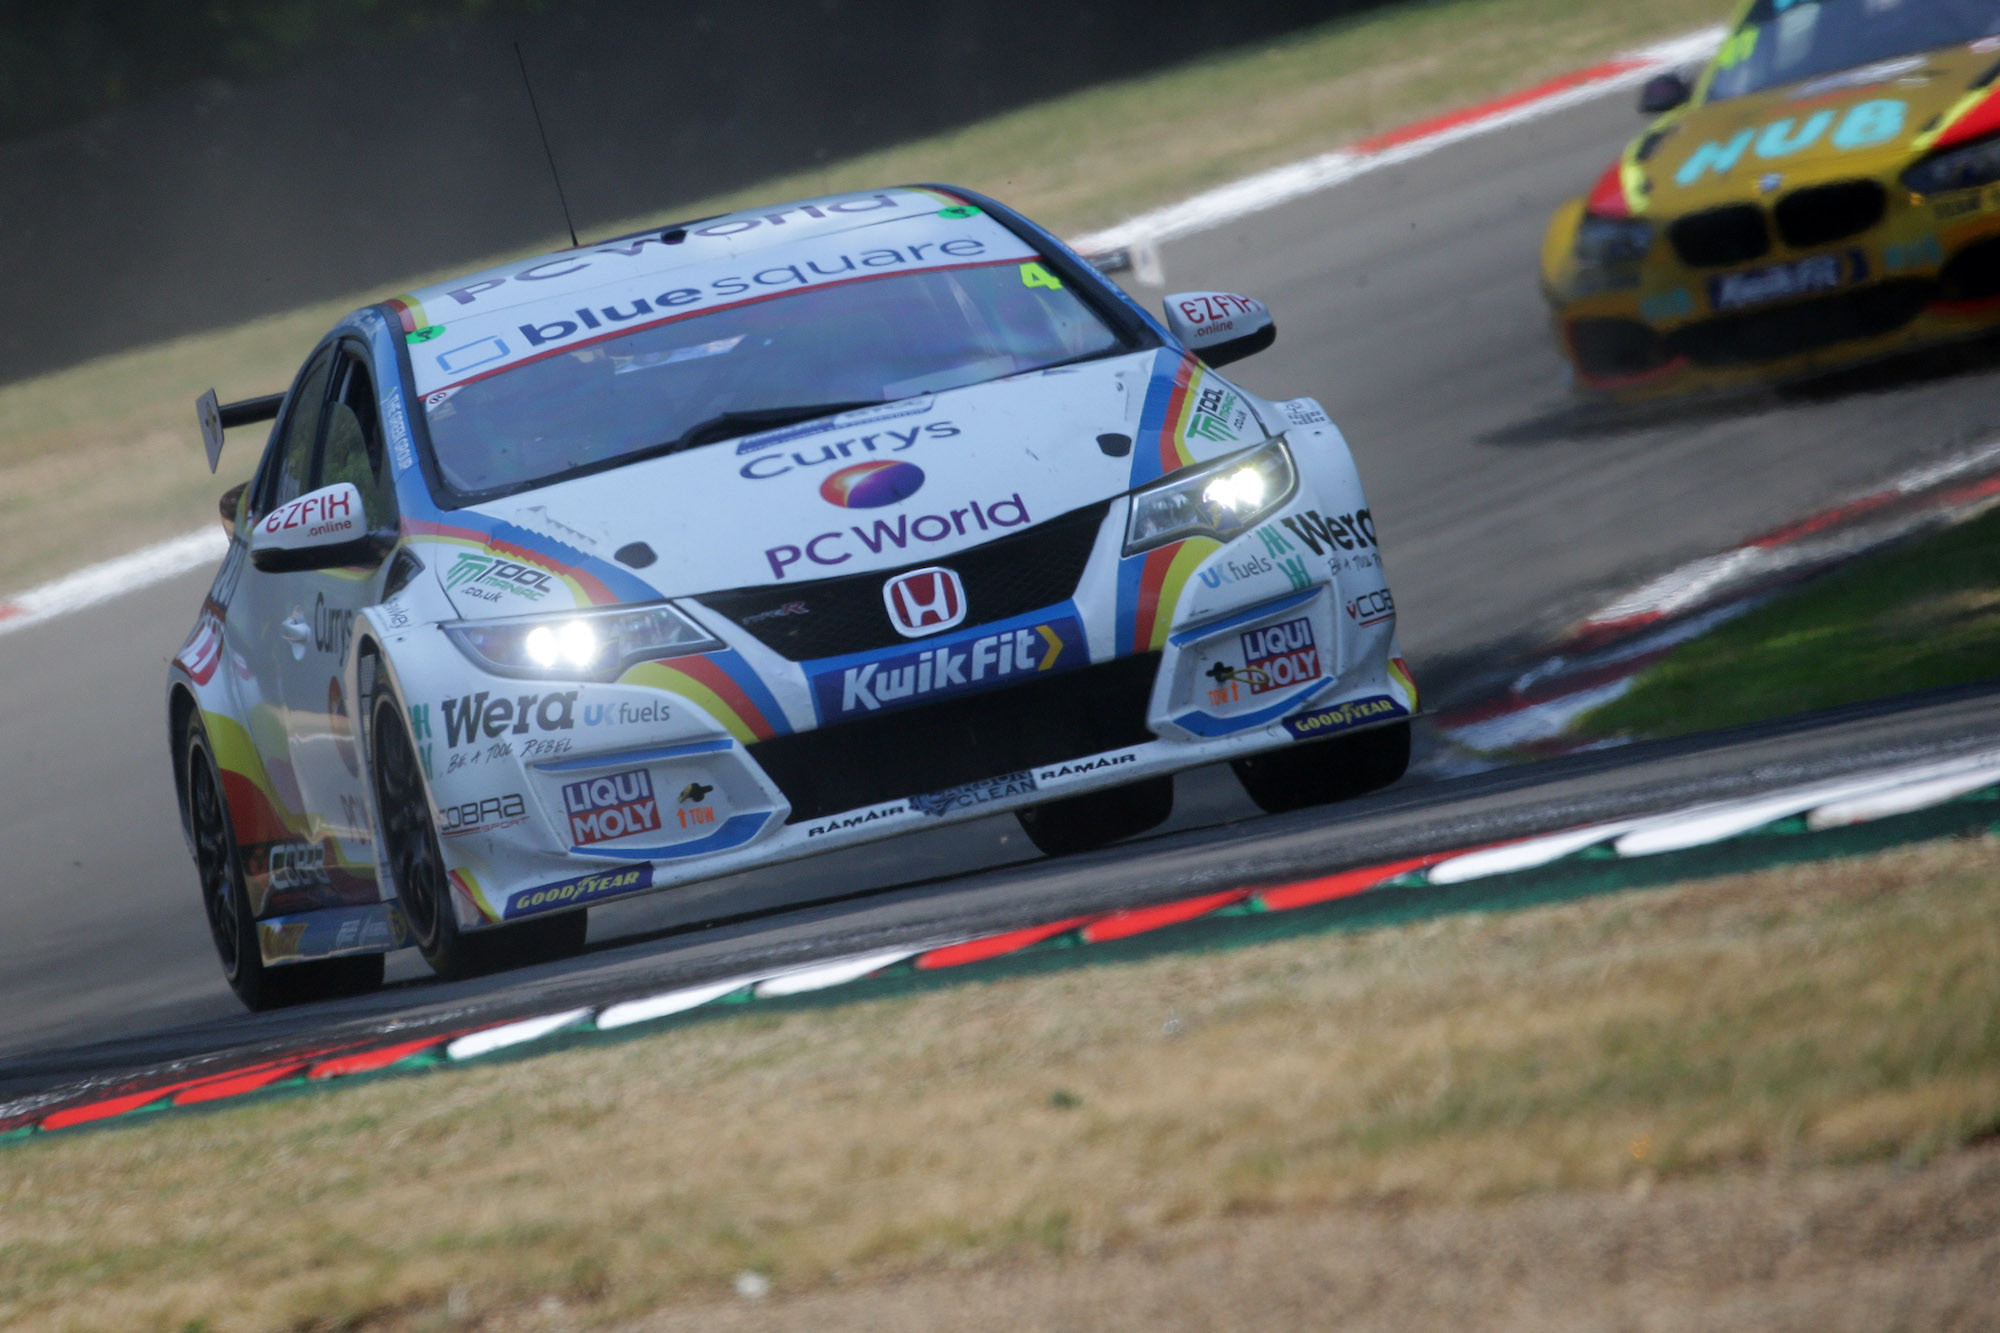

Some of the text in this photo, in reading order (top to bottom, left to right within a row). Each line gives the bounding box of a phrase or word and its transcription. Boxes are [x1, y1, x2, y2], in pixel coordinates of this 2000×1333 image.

[1674, 98, 1908, 188] HUB
[1019, 262, 1064, 291] 4
[740, 420, 961, 479] Currys
[474, 559, 553, 593] TOOL
[1245, 618, 1313, 660] LIQUI
[1250, 650, 1317, 691] MOLY
[441, 690, 578, 749] Wera
[520, 737, 574, 758] REBEL
[565, 770, 650, 814] LIQUI
[572, 801, 655, 843] MOLY
[688, 806, 715, 826] TOW
